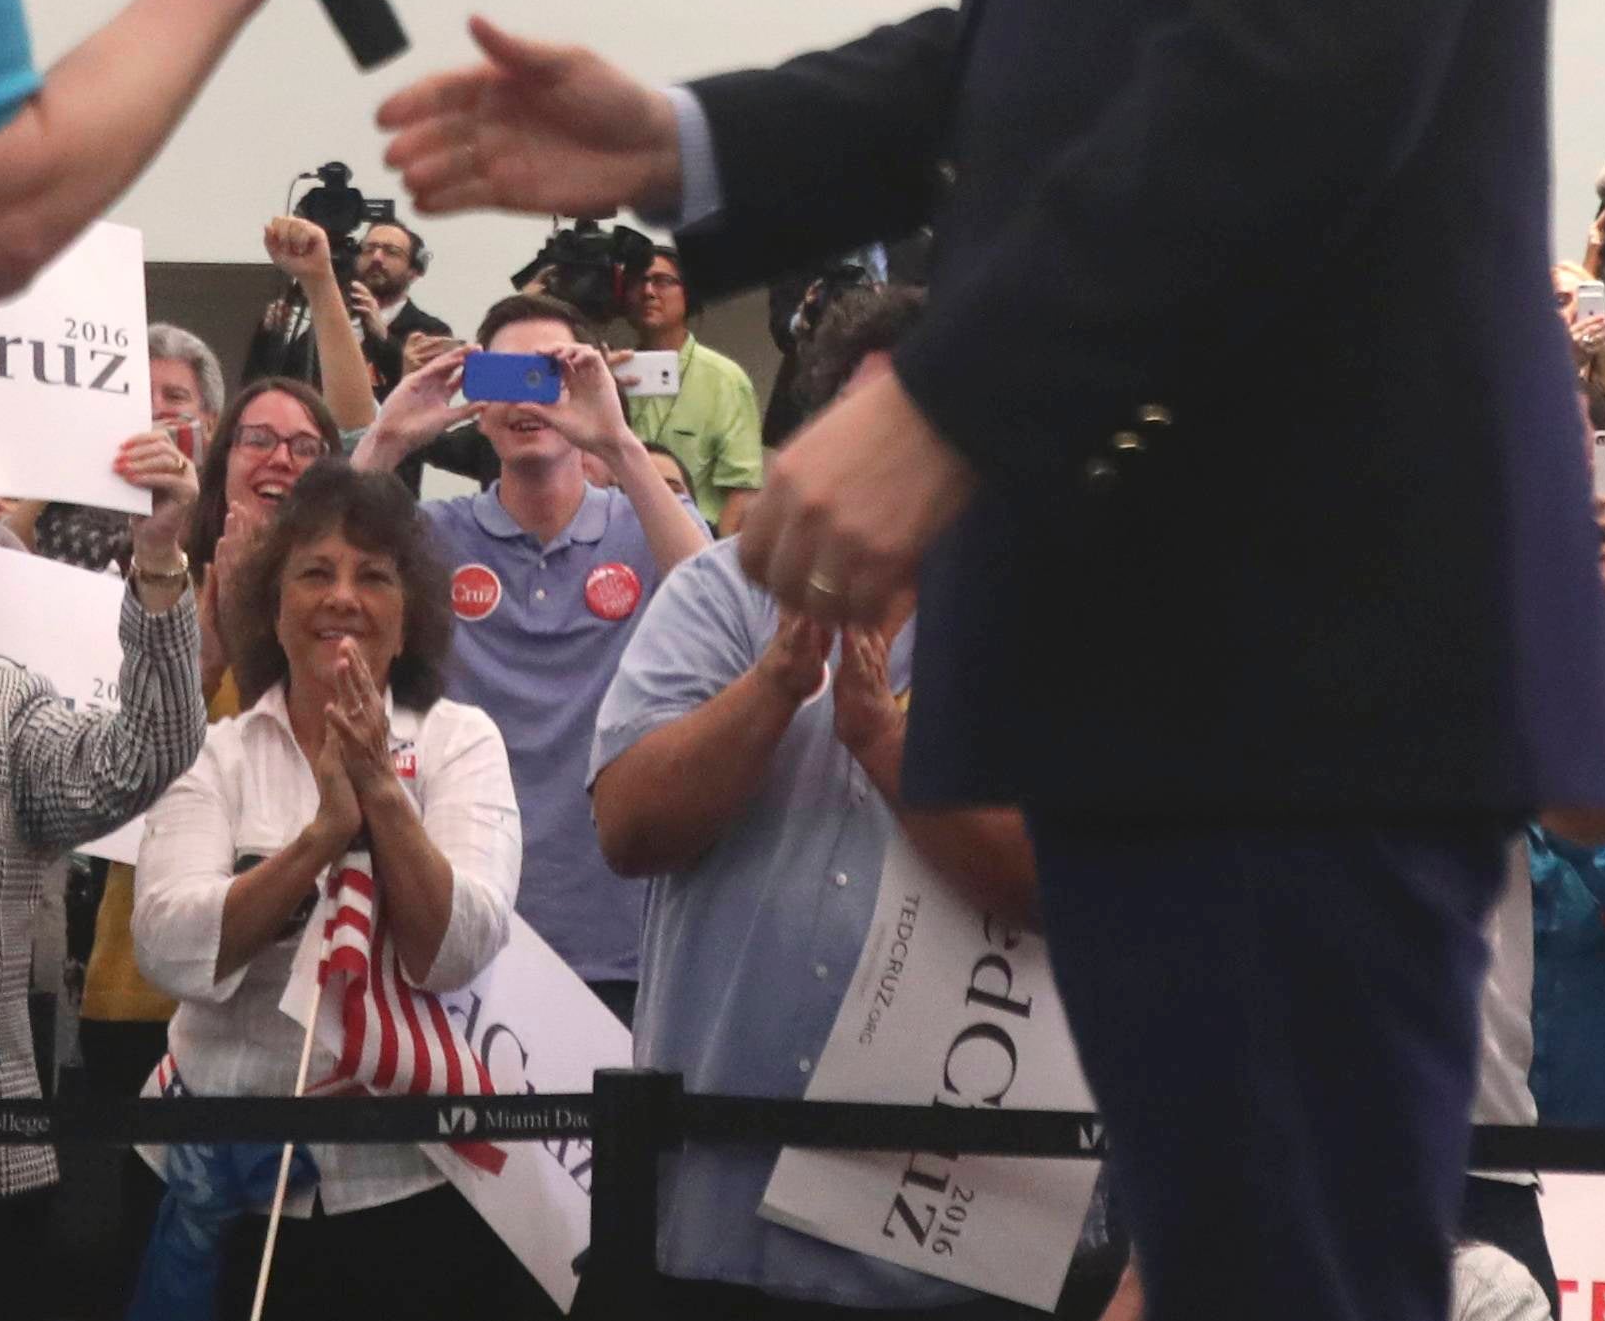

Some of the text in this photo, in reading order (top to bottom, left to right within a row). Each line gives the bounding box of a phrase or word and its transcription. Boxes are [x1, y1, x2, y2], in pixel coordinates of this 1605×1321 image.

[64, 317, 129, 348] 2016
[487, 1108, 550, 1129] Miami
[931, 1185, 975, 1257] 2016
